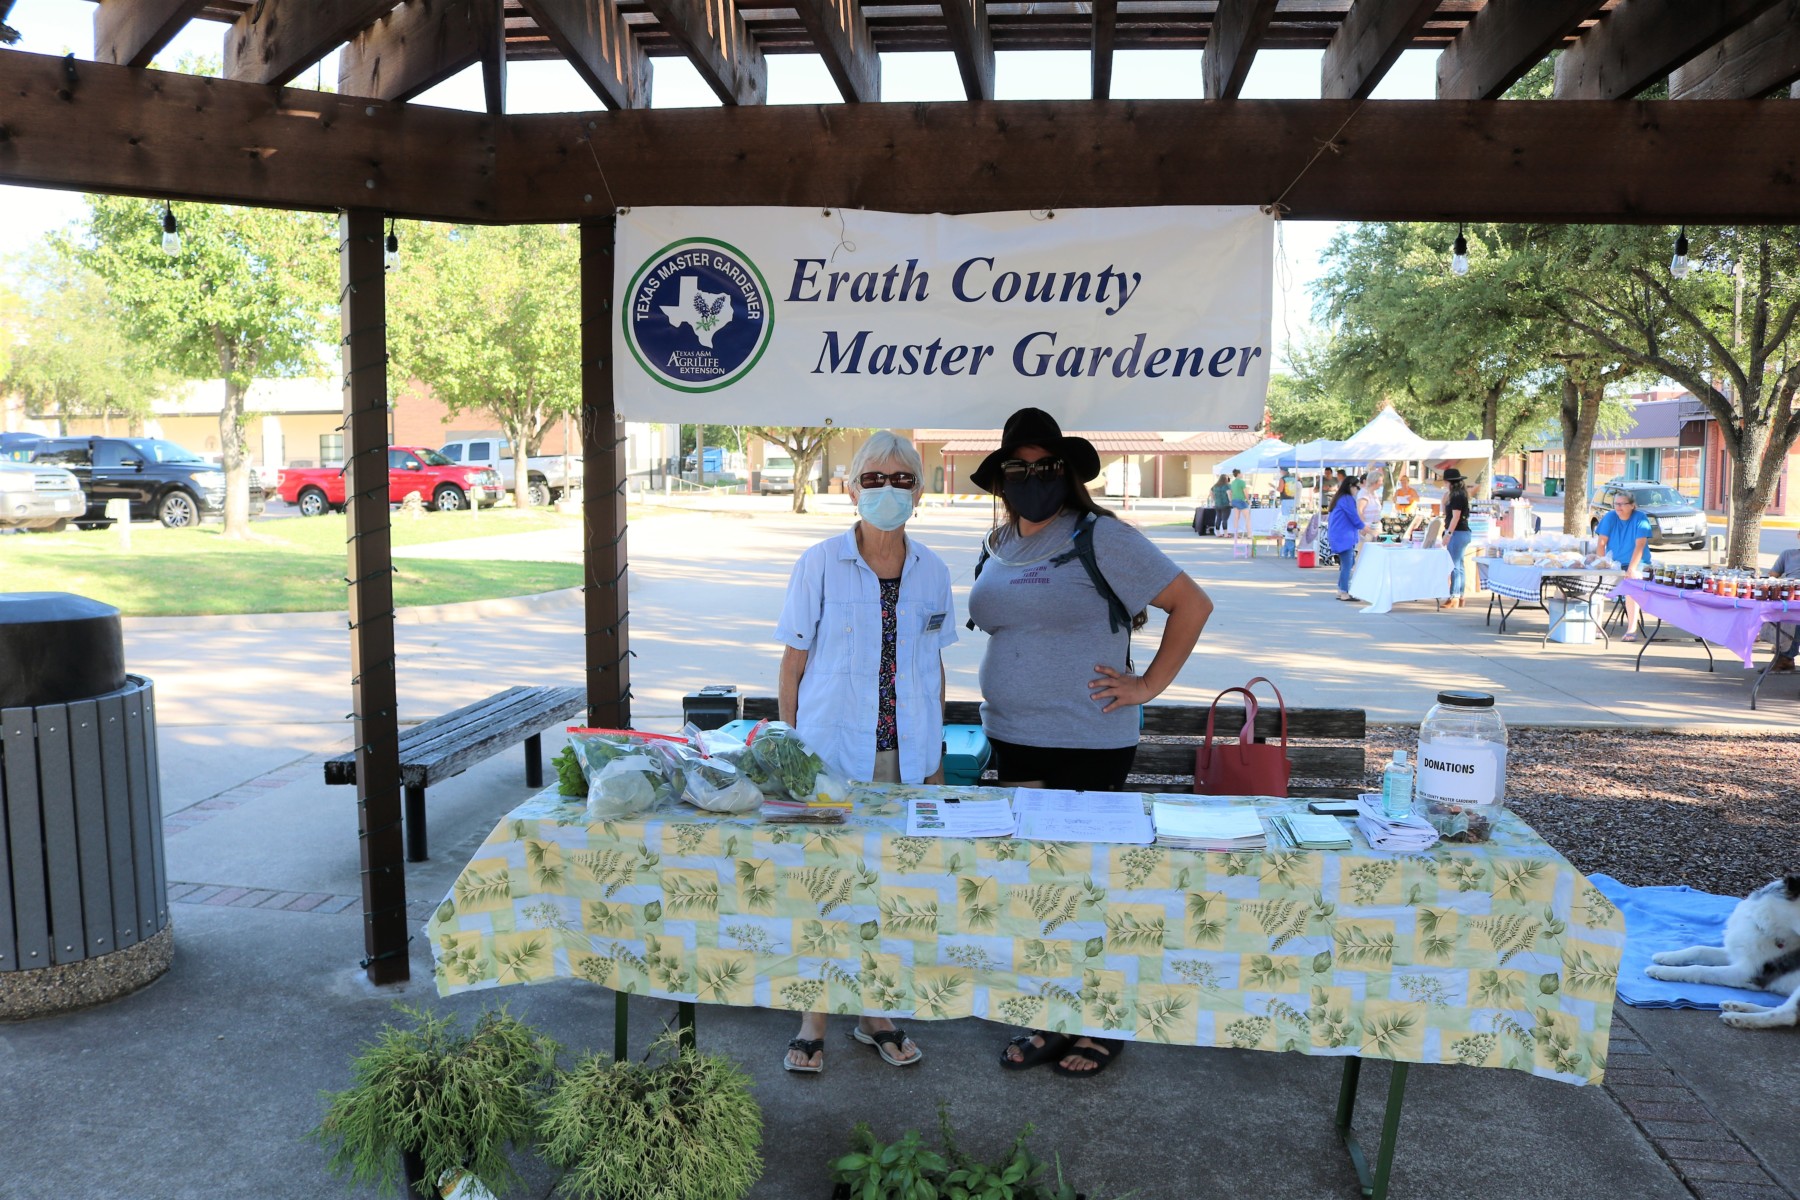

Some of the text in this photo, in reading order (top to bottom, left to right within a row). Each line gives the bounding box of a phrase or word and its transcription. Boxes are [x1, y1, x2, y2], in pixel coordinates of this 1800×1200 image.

[636, 253, 761, 321] TEXAS MASTER GARDENER
[783, 257, 1142, 316] Erath County
[810, 330, 1262, 378] Master Gardener
[680, 367, 725, 375] EXTENSION
[1625, 439, 1642, 447] ETC
[1424, 757, 1475, 775] DONATIONS
